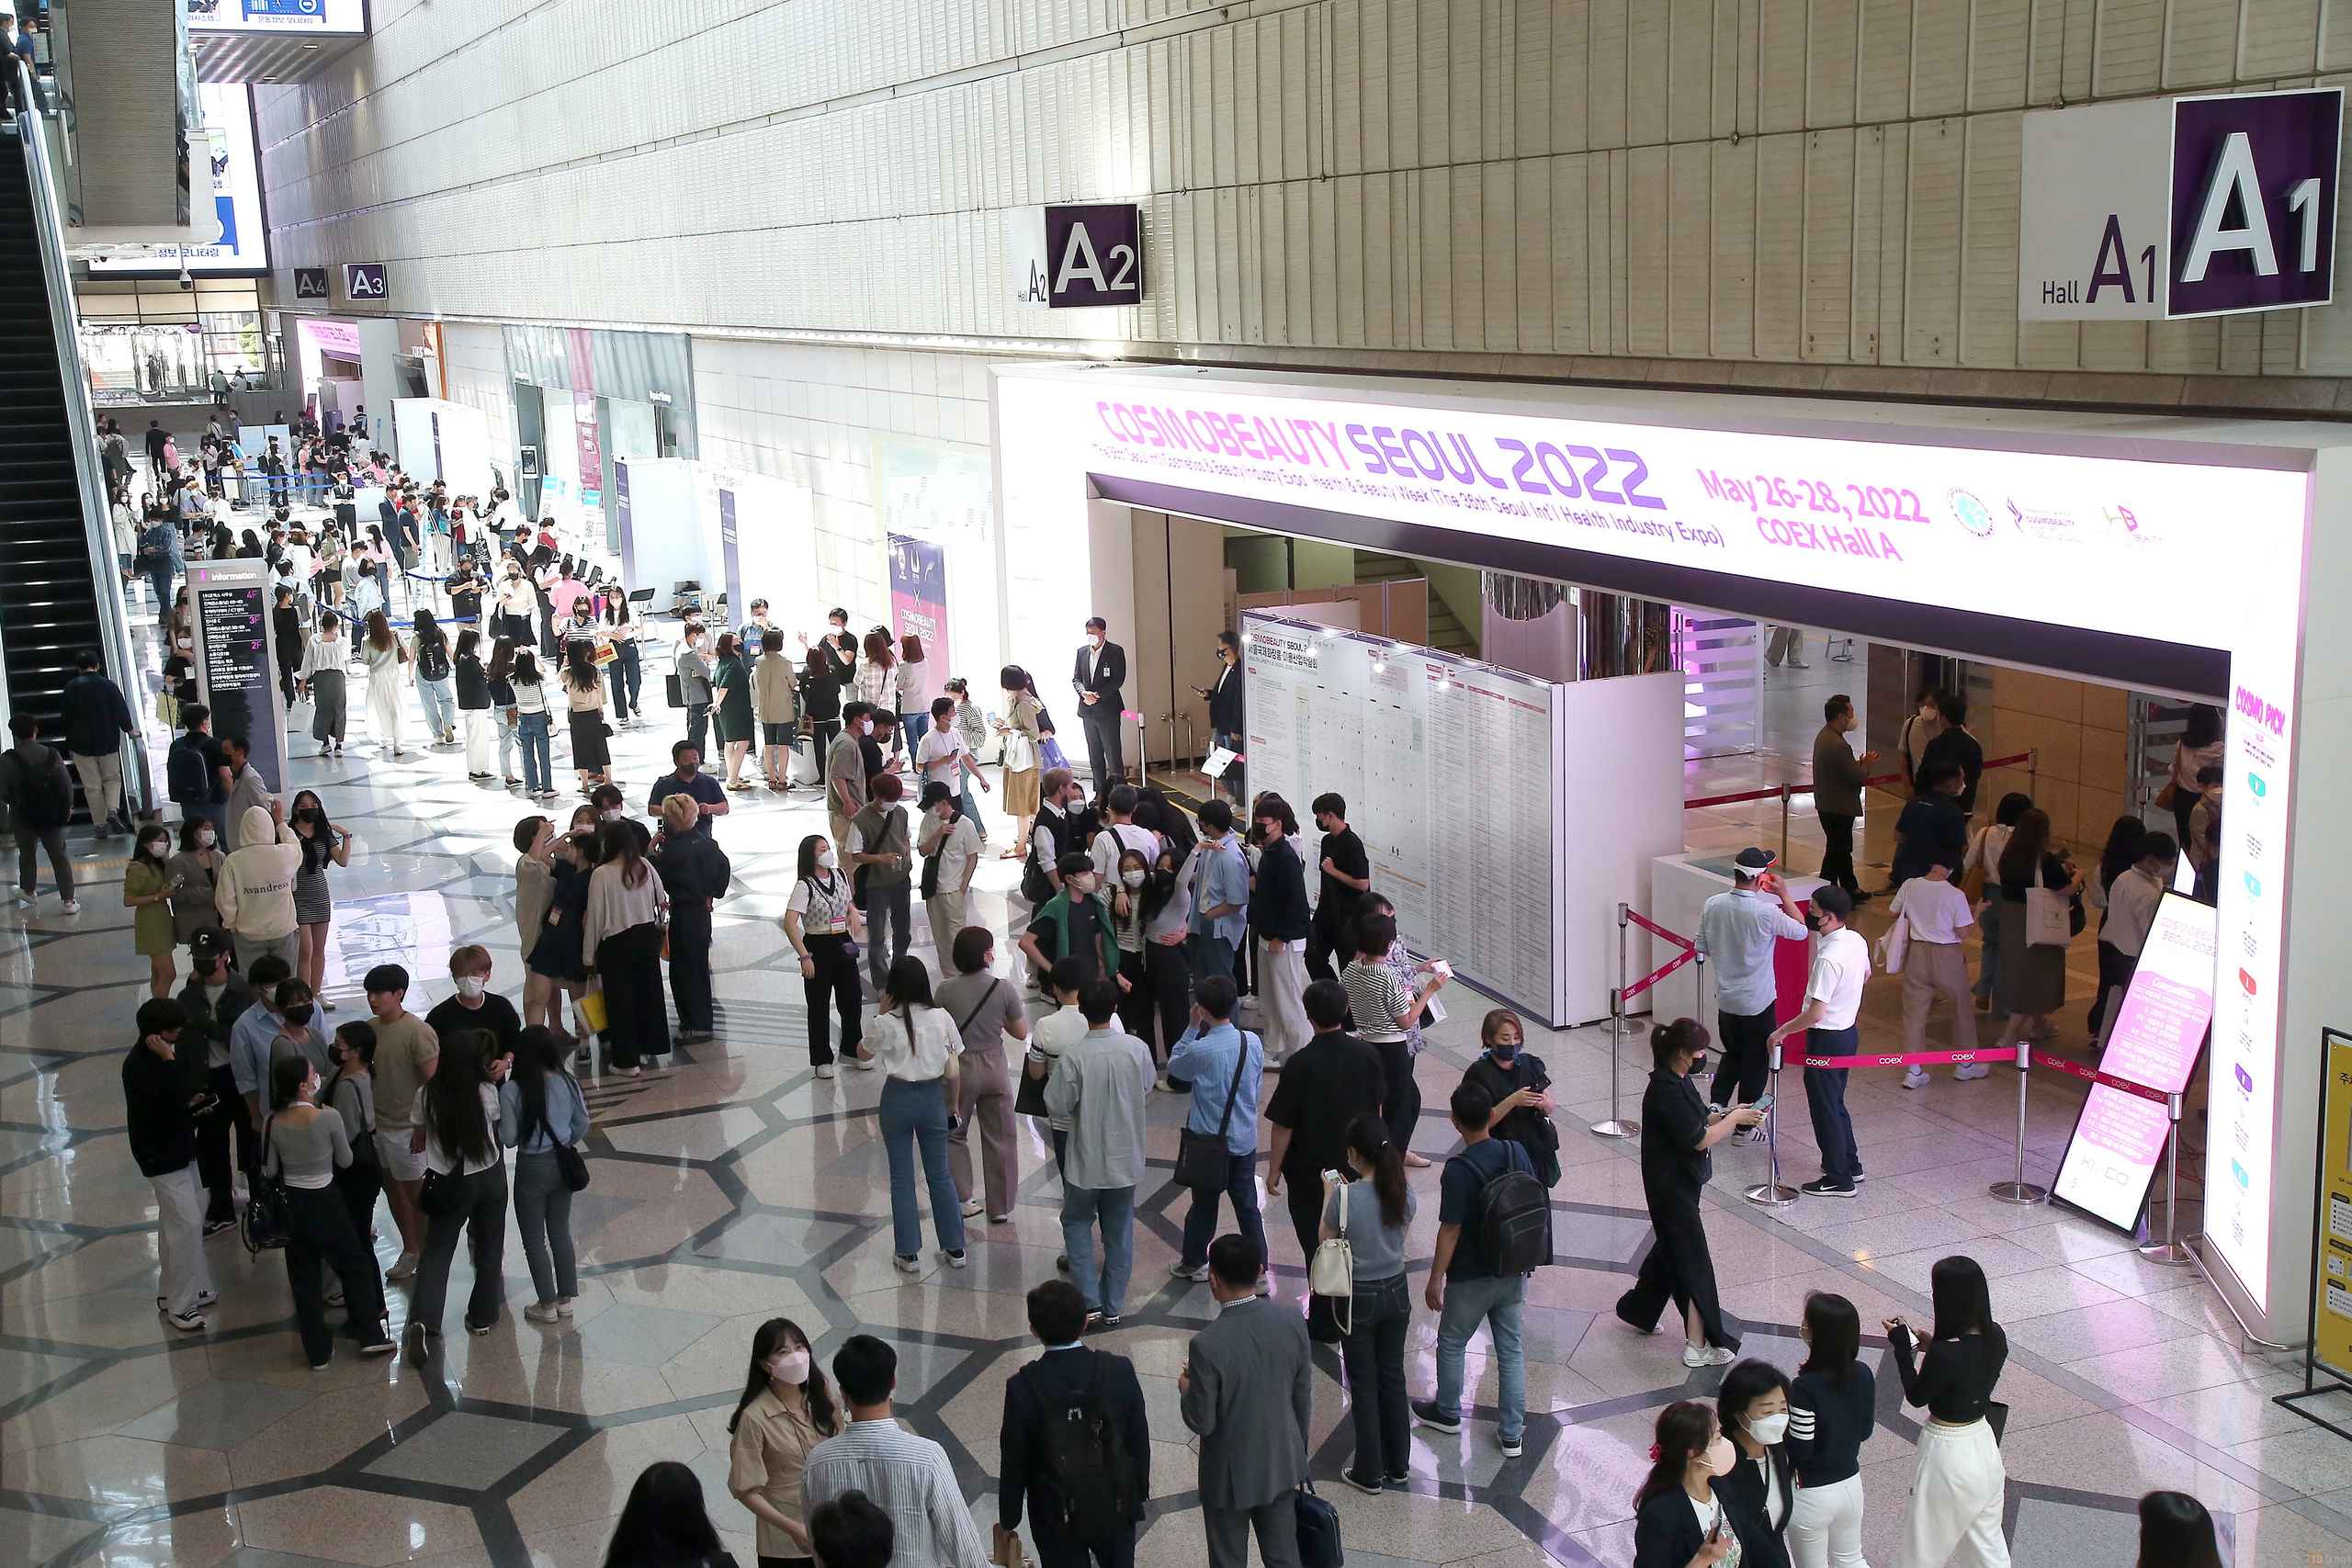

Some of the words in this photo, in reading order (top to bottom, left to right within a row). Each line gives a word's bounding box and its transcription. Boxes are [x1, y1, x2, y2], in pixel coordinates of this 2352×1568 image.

[2179, 131, 2321, 283] A1
[1054, 221, 1136, 293] A2
[2042, 281, 2080, 304] Hall
[2086, 214, 2156, 303] A1
[299, 273, 325, 294] A4
[352, 270, 384, 295] A3
[1028, 259, 1046, 302] A2
[1095, 401, 1351, 470] COSMOBEAUTY
[1345, 423, 1509, 490] SEOUL
[1494, 437, 1668, 510] 2022
[1696, 468, 1758, 512] May
[1491, 496, 1532, 518] Seoul
[1560, 504, 1611, 530] Health
[1610, 512, 1675, 542] Industry
[1675, 520, 1725, 548] Expo)
[1756, 517, 1826, 550] COEX
[1821, 524, 1881, 558] Hall
[1879, 532, 1904, 561] A
[246, 590, 257, 599] 4F
[249, 616, 261, 625] 3F
[1246, 633, 1286, 649] OSMOBEAUTY
[251, 641, 262, 649] 2F
[2235, 685, 2263, 724] COSMO
[1805, 1057, 1831, 1066] coex
[1879, 1055, 1904, 1065] coex
[1951, 1051, 1975, 1061] coex
